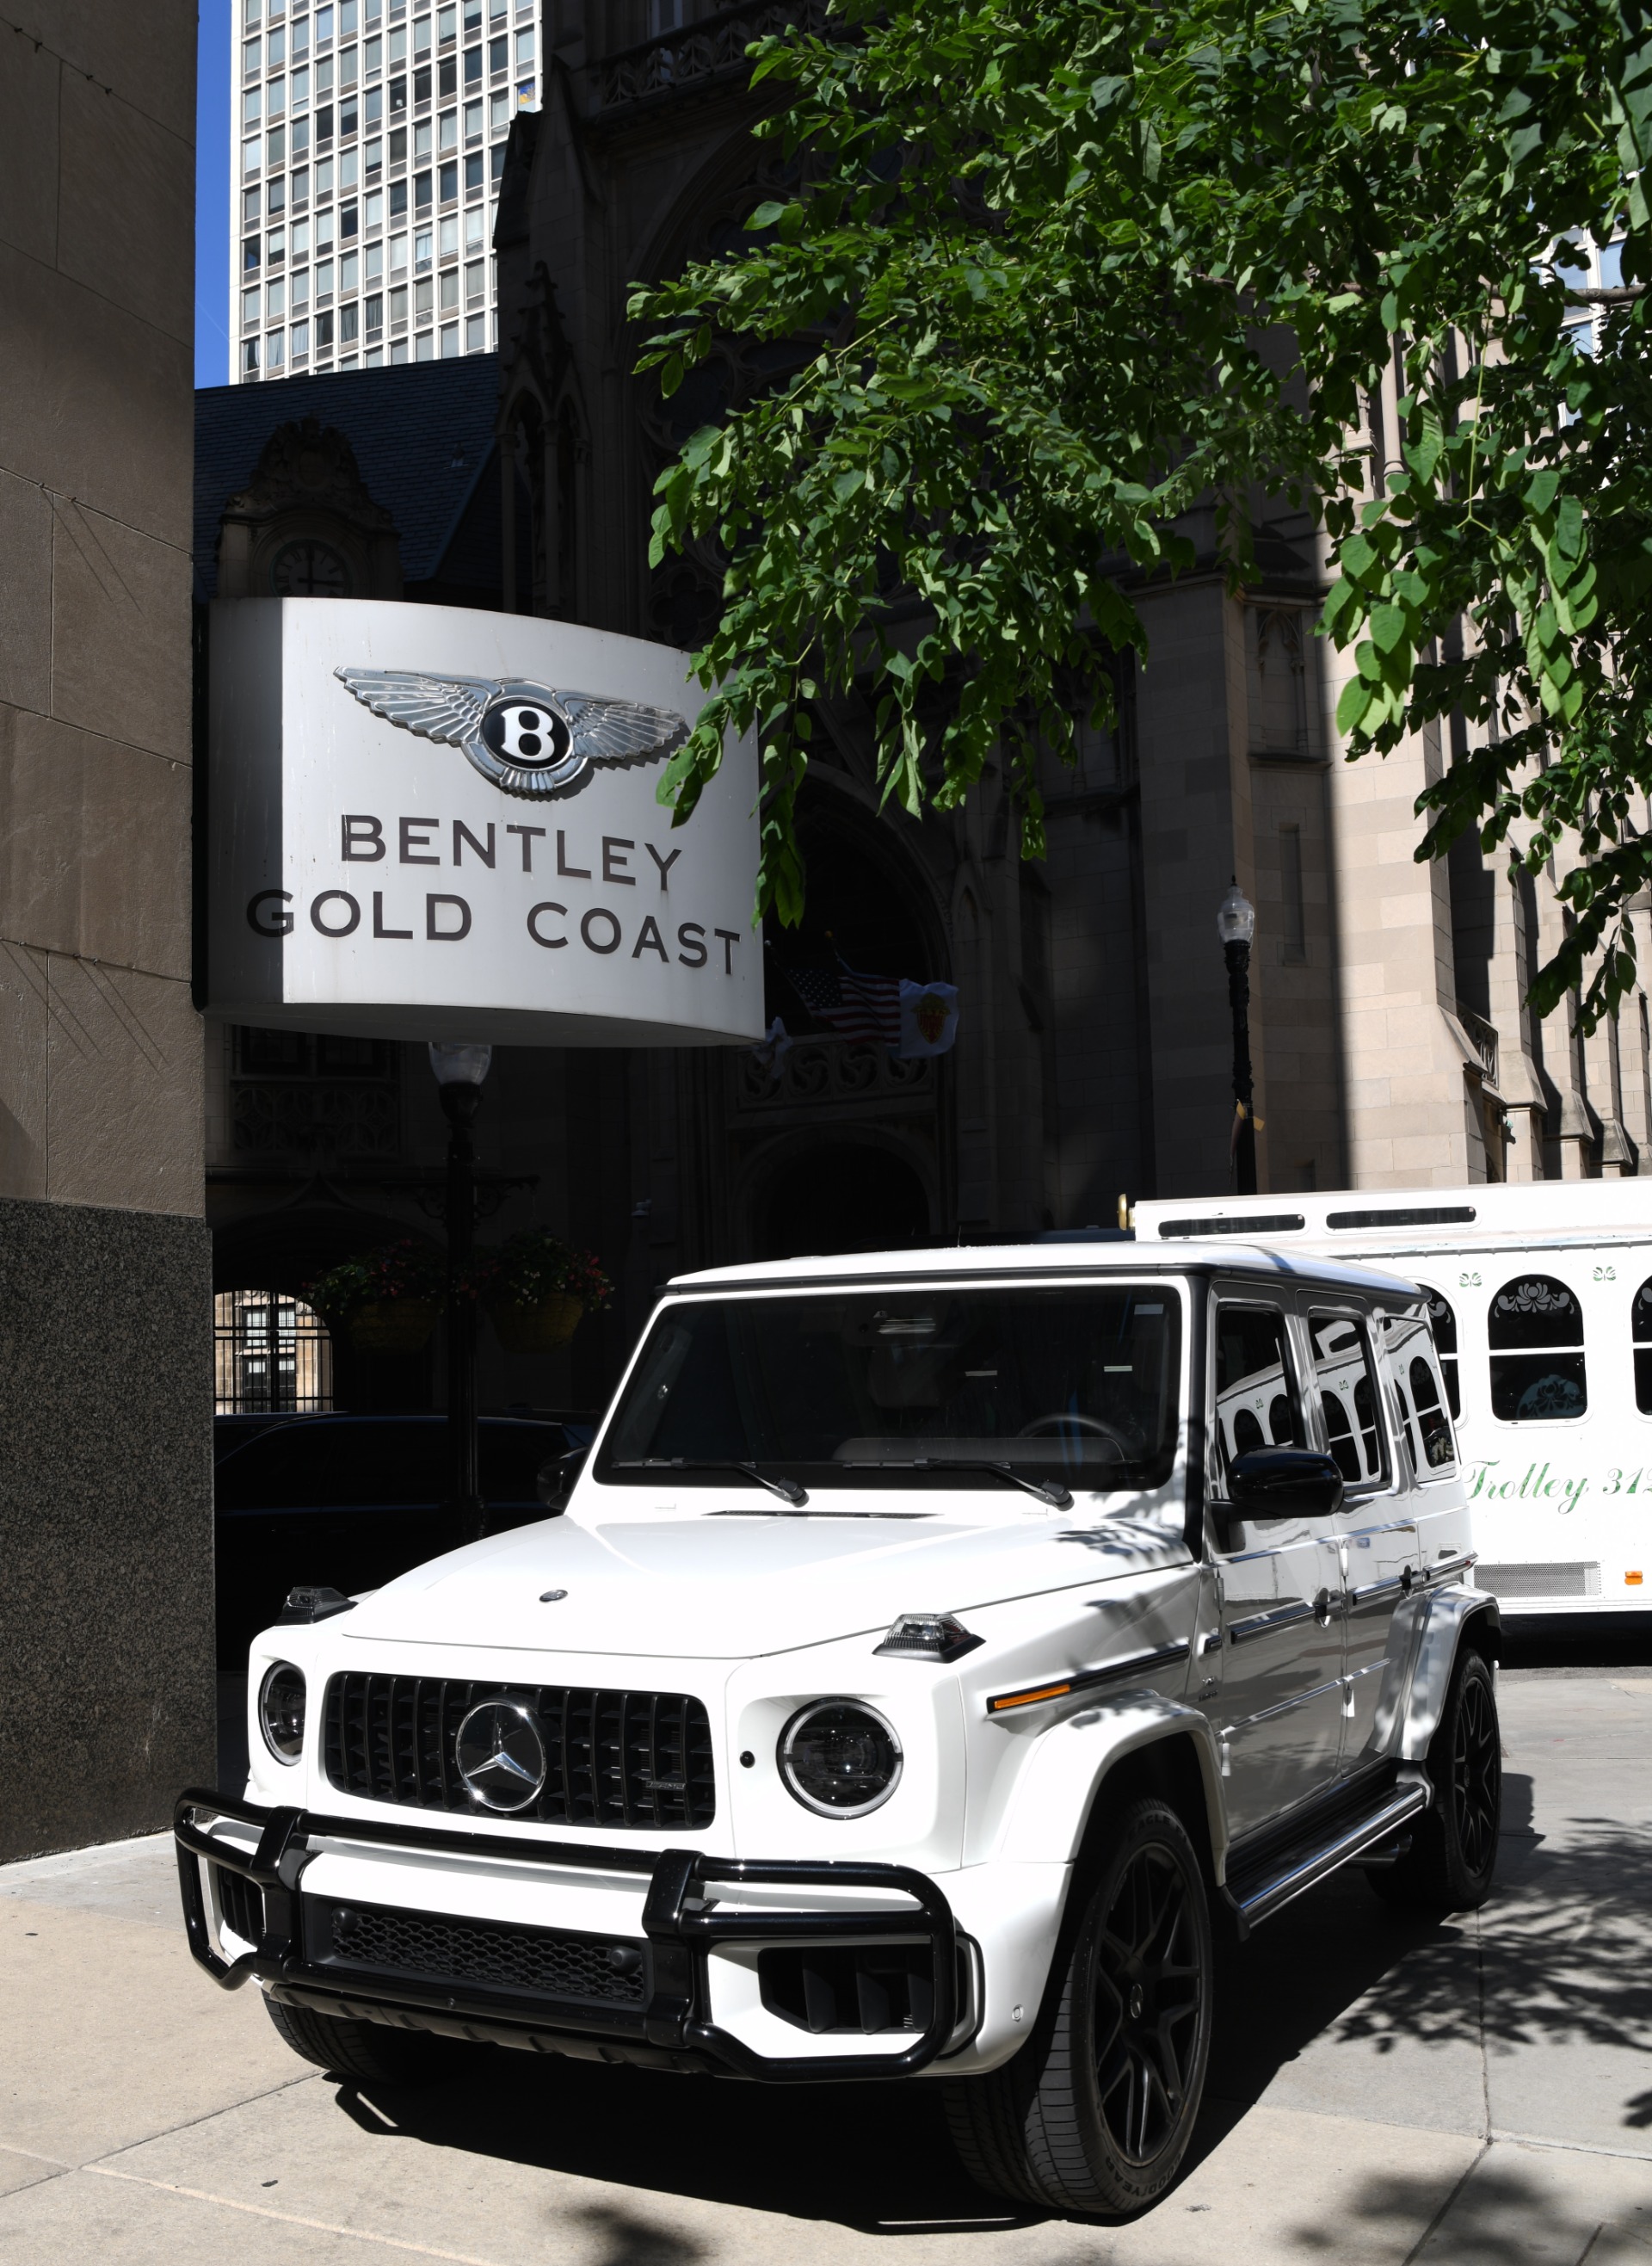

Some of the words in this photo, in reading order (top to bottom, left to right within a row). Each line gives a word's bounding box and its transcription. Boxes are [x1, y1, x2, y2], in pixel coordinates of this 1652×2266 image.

[501, 706, 555, 761] B
[342, 814, 683, 891] BENTLEY
[246, 889, 472, 942] GOLD
[527, 901, 743, 975] COAST
[1463, 1460, 1590, 1515] Trolley
